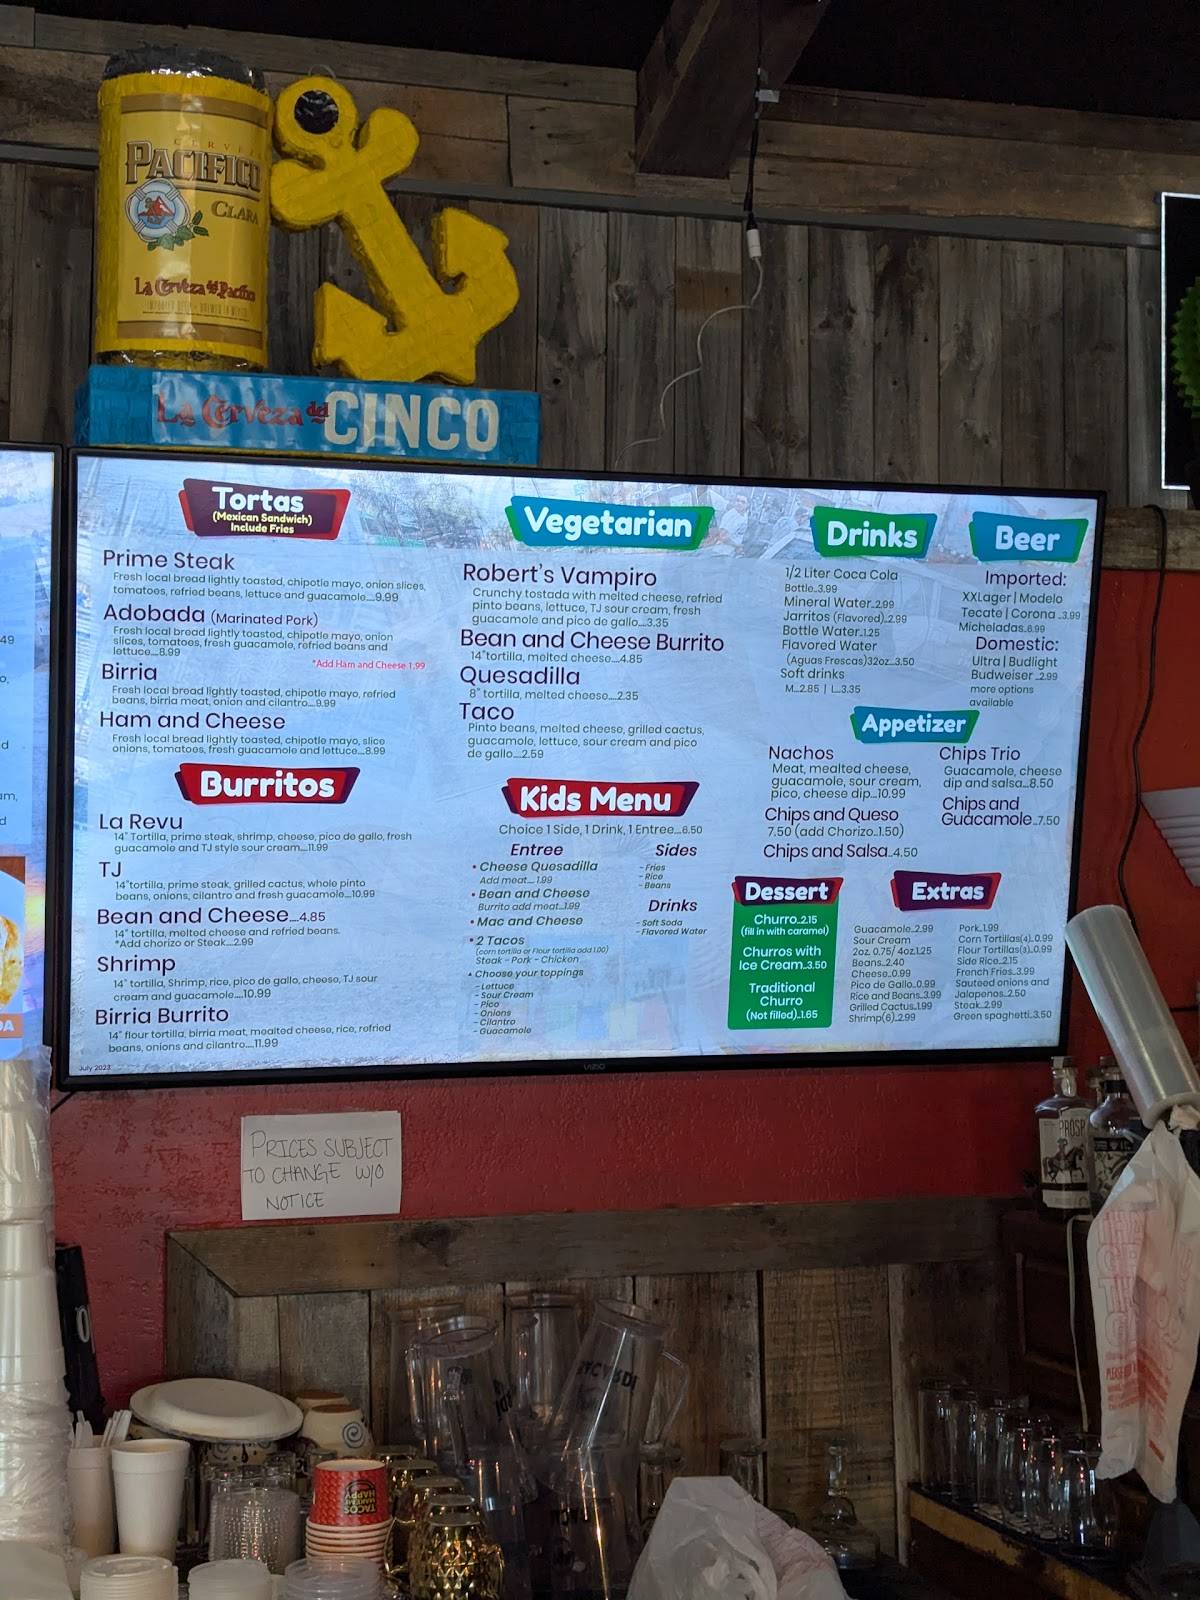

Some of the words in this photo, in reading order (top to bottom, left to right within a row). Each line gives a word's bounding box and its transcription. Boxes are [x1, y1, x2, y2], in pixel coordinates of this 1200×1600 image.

[125, 140, 261, 193] PACIFICO
[211, 200, 259, 225] CLARA
[156, 392, 196, 426] La
[202, 394, 304, 430] Cerveza
[307, 400, 330, 423] del
[323, 390, 500, 452] CINCO
[211, 486, 305, 513] Tortas
[212, 511, 260, 524] (Mexican
[260, 512, 313, 527] Sandwich)
[523, 506, 693, 542] Vegetarian
[230, 523, 268, 534] Include
[269, 524, 295, 535] Fries
[827, 520, 918, 549] Drinks
[995, 525, 1061, 552] Beer
[103, 549, 167, 569] Prime
[174, 551, 234, 570] Steak
[113, 572, 142, 581] Fresh
[145, 573, 170, 582] local
[173, 574, 205, 583] bread
[208, 575, 240, 586] lightly
[242, 576, 285, 586] toasted,
[287, 577, 329, 589] chipotle
[331, 581, 363, 590] mayo,
[365, 580, 393, 589] onion
[396, 581, 425, 591] slices,
[560, 566, 656, 590] Vampiro
[785, 567, 801, 580] 1/2
[804, 567, 830, 579] Liter
[833, 568, 866, 580] Coca
[869, 569, 897, 580] Cola
[985, 570, 1066, 590] Imported:
[472, 588, 522, 601] Crunchy
[524, 590, 569, 599] tostada
[571, 591, 595, 600] with
[598, 591, 638, 601] melted
[641, 592, 683, 603] cheese,
[686, 593, 722, 603] refried
[962, 592, 1011, 606] XXLager
[1019, 592, 1062, 604] Modelo
[103, 605, 204, 623] Adobada
[210, 613, 282, 627] (Marinated
[286, 614, 317, 627] Pork)
[461, 629, 515, 647] Bean
[522, 630, 564, 648] and
[570, 631, 650, 650] Cheese
[656, 633, 723, 651] Burrito
[782, 639, 835, 650] Flavored
[839, 640, 877, 650] Water
[975, 636, 1058, 651] Domestic:
[972, 656, 1000, 667] Ultra
[1008, 656, 1057, 670] Budlight
[102, 663, 156, 681] Birria
[459, 667, 579, 688] Quesadilla
[780, 667, 804, 678] Soft
[807, 667, 844, 678] drinks
[997, 685, 1033, 696] options
[969, 698, 1013, 707] available
[459, 703, 514, 720] Taco
[100, 711, 150, 728] Ham
[157, 711, 199, 728] and
[205, 712, 285, 729] Cheese
[861, 713, 967, 738] Appetizer
[768, 745, 833, 760] Nachos
[939, 746, 986, 764] Chips
[990, 746, 1020, 760] Trio
[772, 763, 805, 774] Meat,
[809, 763, 861, 774] mealted
[864, 764, 910, 775] cheese,
[943, 766, 1016, 777] Guacamole,
[1019, 766, 1061, 775] cheese
[200, 770, 336, 798] Burritos
[520, 785, 582, 812] Kids
[589, 785, 672, 812] Menu
[942, 796, 985, 814] Chips
[988, 796, 1019, 810] and
[99, 813, 122, 829] La
[129, 813, 182, 829] Revu
[764, 807, 809, 825] Chips
[813, 807, 845, 821] and
[848, 807, 898, 823] Queso
[510, 843, 563, 856] Entree
[655, 843, 697, 856] Sides
[98, 861, 121, 877] TJ
[479, 861, 527, 871] Cheese
[530, 861, 598, 873] Quesadilla
[478, 888, 511, 898] Bean
[514, 888, 540, 898] and
[542, 888, 589, 898] Cheese
[745, 882, 829, 901] Dessert
[911, 881, 984, 901] Extras
[648, 898, 697, 911] Drinks
[97, 908, 152, 924] Bean
[159, 908, 201, 924] and
[476, 915, 504, 926] Mac
[507, 915, 533, 925] and
[535, 915, 583, 925] Cheese
[131, 929, 166, 938] tortilla,
[208, 928, 246, 936] cheese
[271, 927, 304, 935] refried
[740, 926, 754, 936] (fill
[756, 926, 764, 935] in
[766, 926, 785, 935] with
[787, 926, 829, 936] caramel)
[475, 935, 483, 945] 2
[487, 934, 524, 945] Tacos
[742, 945, 792, 956] Churros
[795, 945, 821, 956] with
[97, 955, 175, 975] Shrimp
[748, 980, 815, 992] Traditional
[759, 994, 803, 1006] Churro
[95, 1007, 150, 1025] Birria
[158, 1005, 228, 1023] Burrito
[250, 1130, 318, 1158] PRICES
[323, 1137, 393, 1159] SUBJECT
[243, 1167, 265, 1184] TO
[272, 1162, 341, 1184] CHANGE
[355, 1164, 385, 1188] W/O
[266, 1192, 325, 1211] NOTICE
[345, 1490, 375, 1499] HAPPY
[344, 1504, 375, 1514] TACOS
